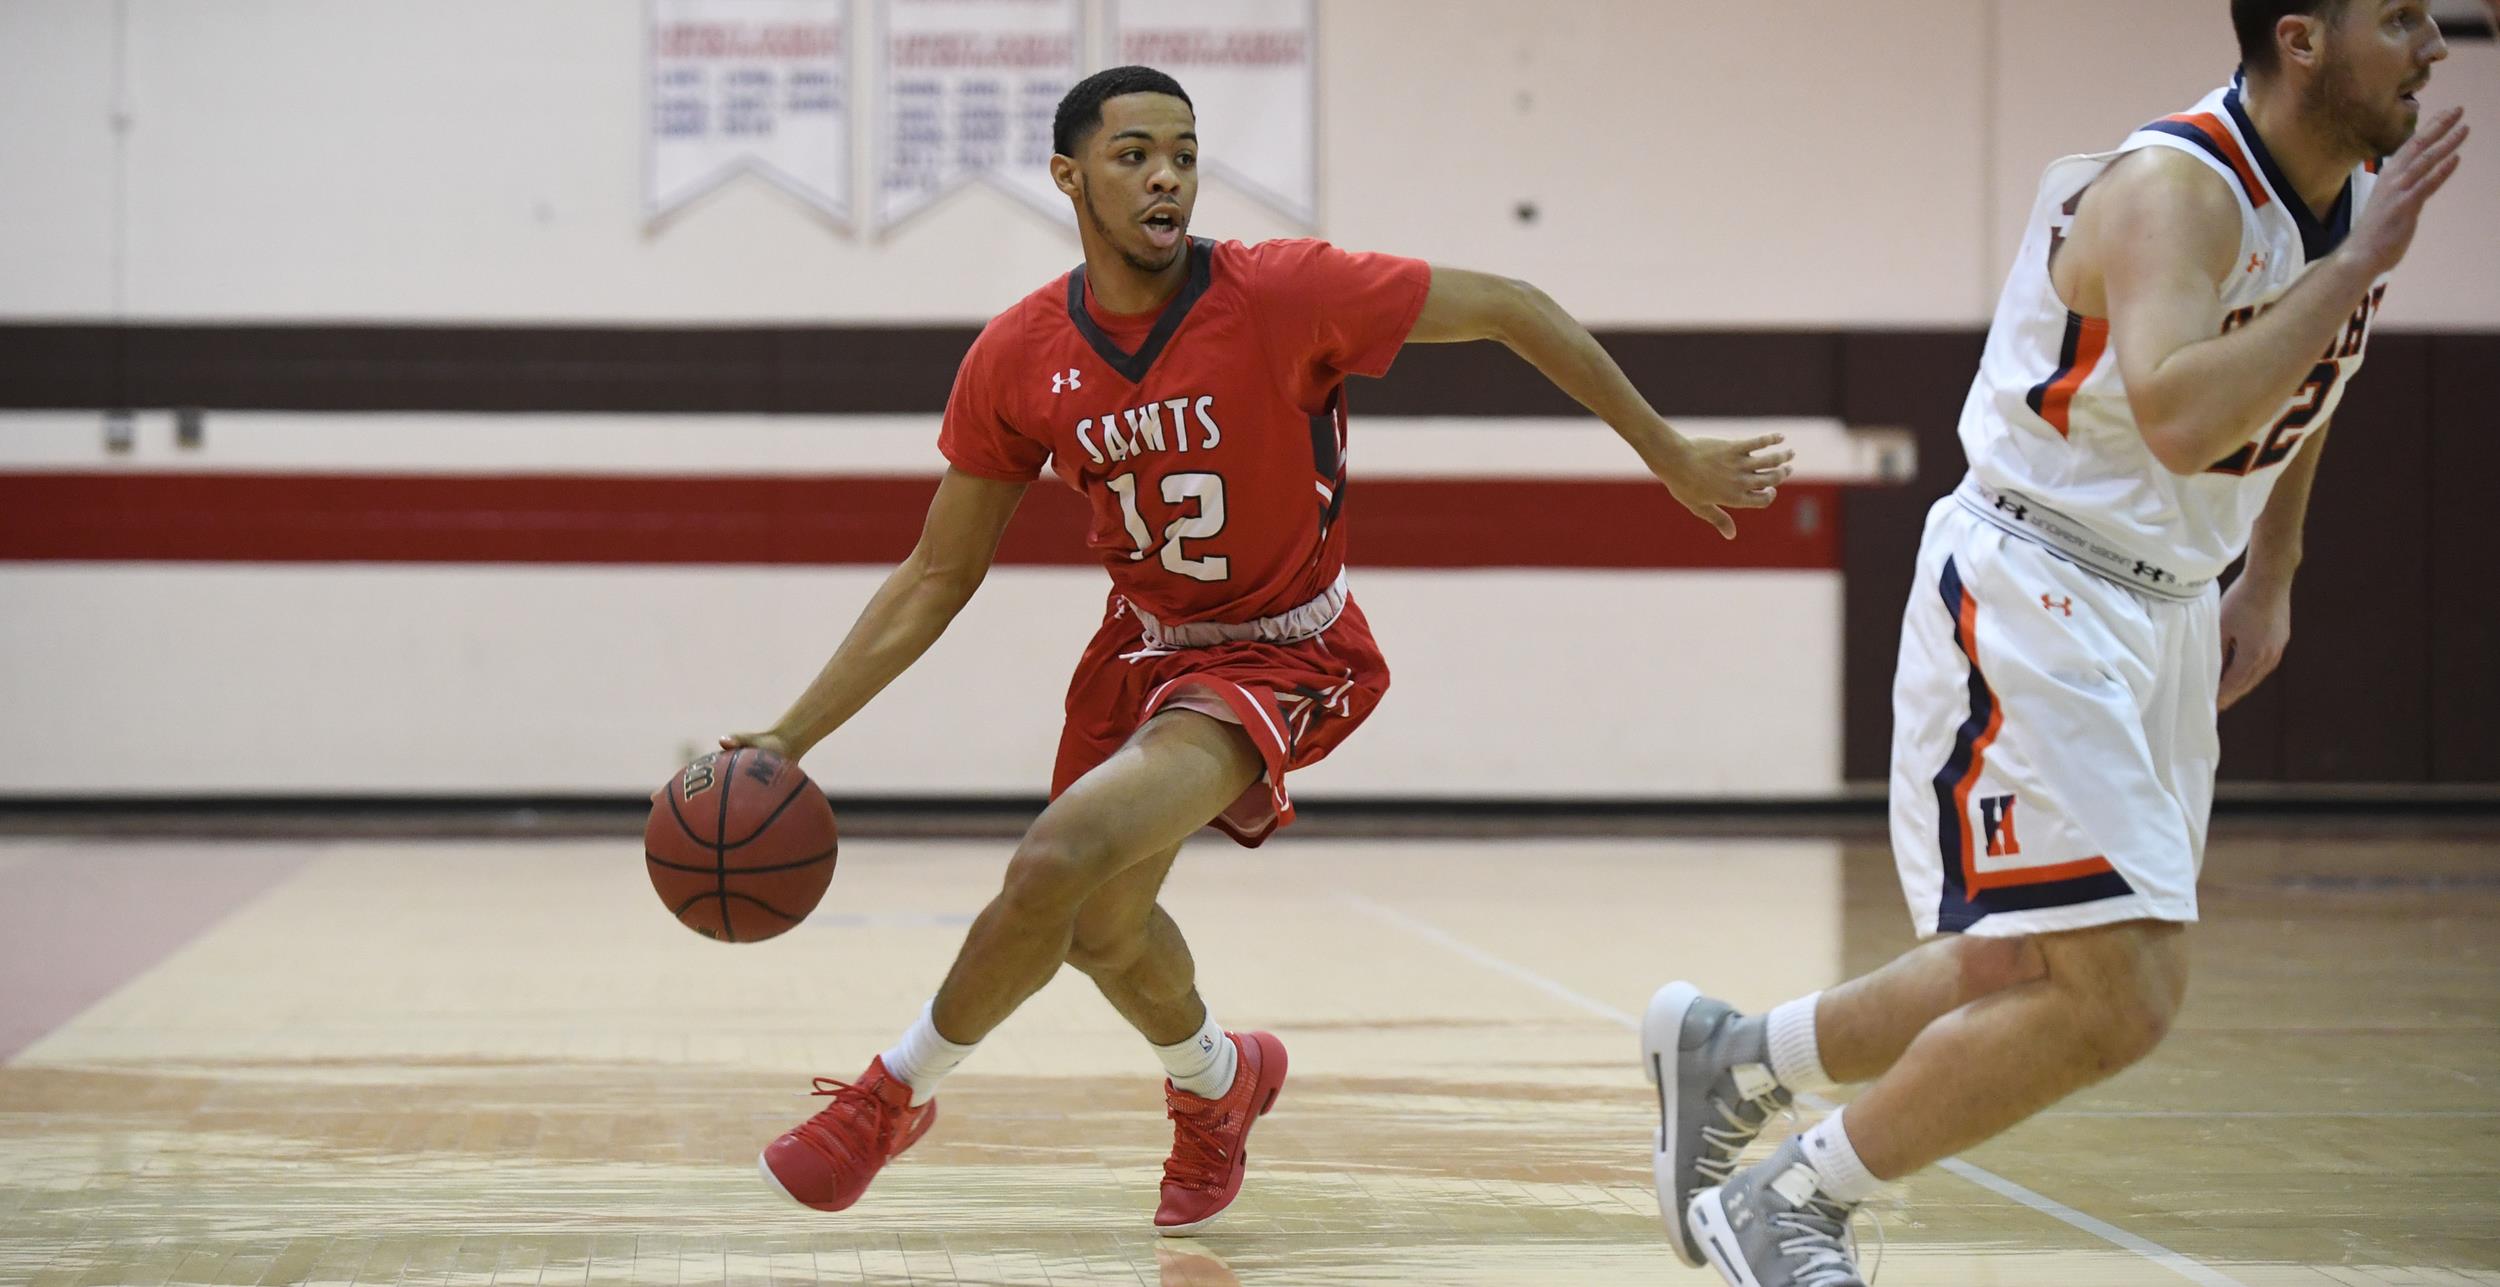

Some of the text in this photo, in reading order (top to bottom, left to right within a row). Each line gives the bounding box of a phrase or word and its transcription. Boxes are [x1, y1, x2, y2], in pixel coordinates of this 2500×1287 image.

[1075, 395, 1221, 464] SAINTS
[2204, 359, 2341, 477] 2
[1106, 472, 1230, 582] 12
[1979, 793, 2022, 858] H
